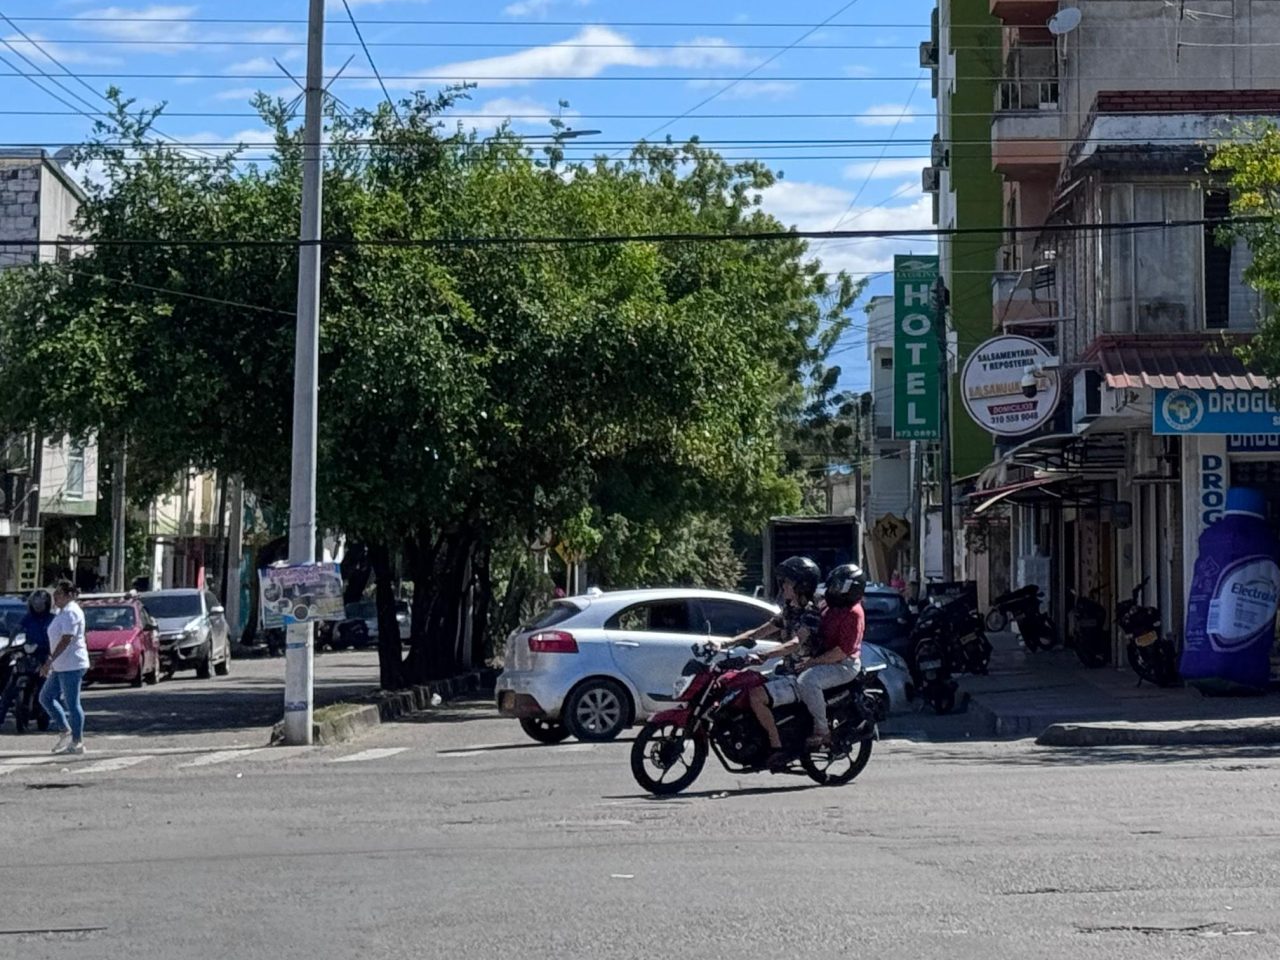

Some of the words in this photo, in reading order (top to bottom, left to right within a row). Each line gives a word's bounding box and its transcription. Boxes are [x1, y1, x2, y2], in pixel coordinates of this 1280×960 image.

[902, 283, 932, 425] HOTEL
[978, 348, 1038, 362] SALSAMENTARIA
[982, 364, 988, 372] Y
[990, 358, 1034, 371] REPOSTERIA
